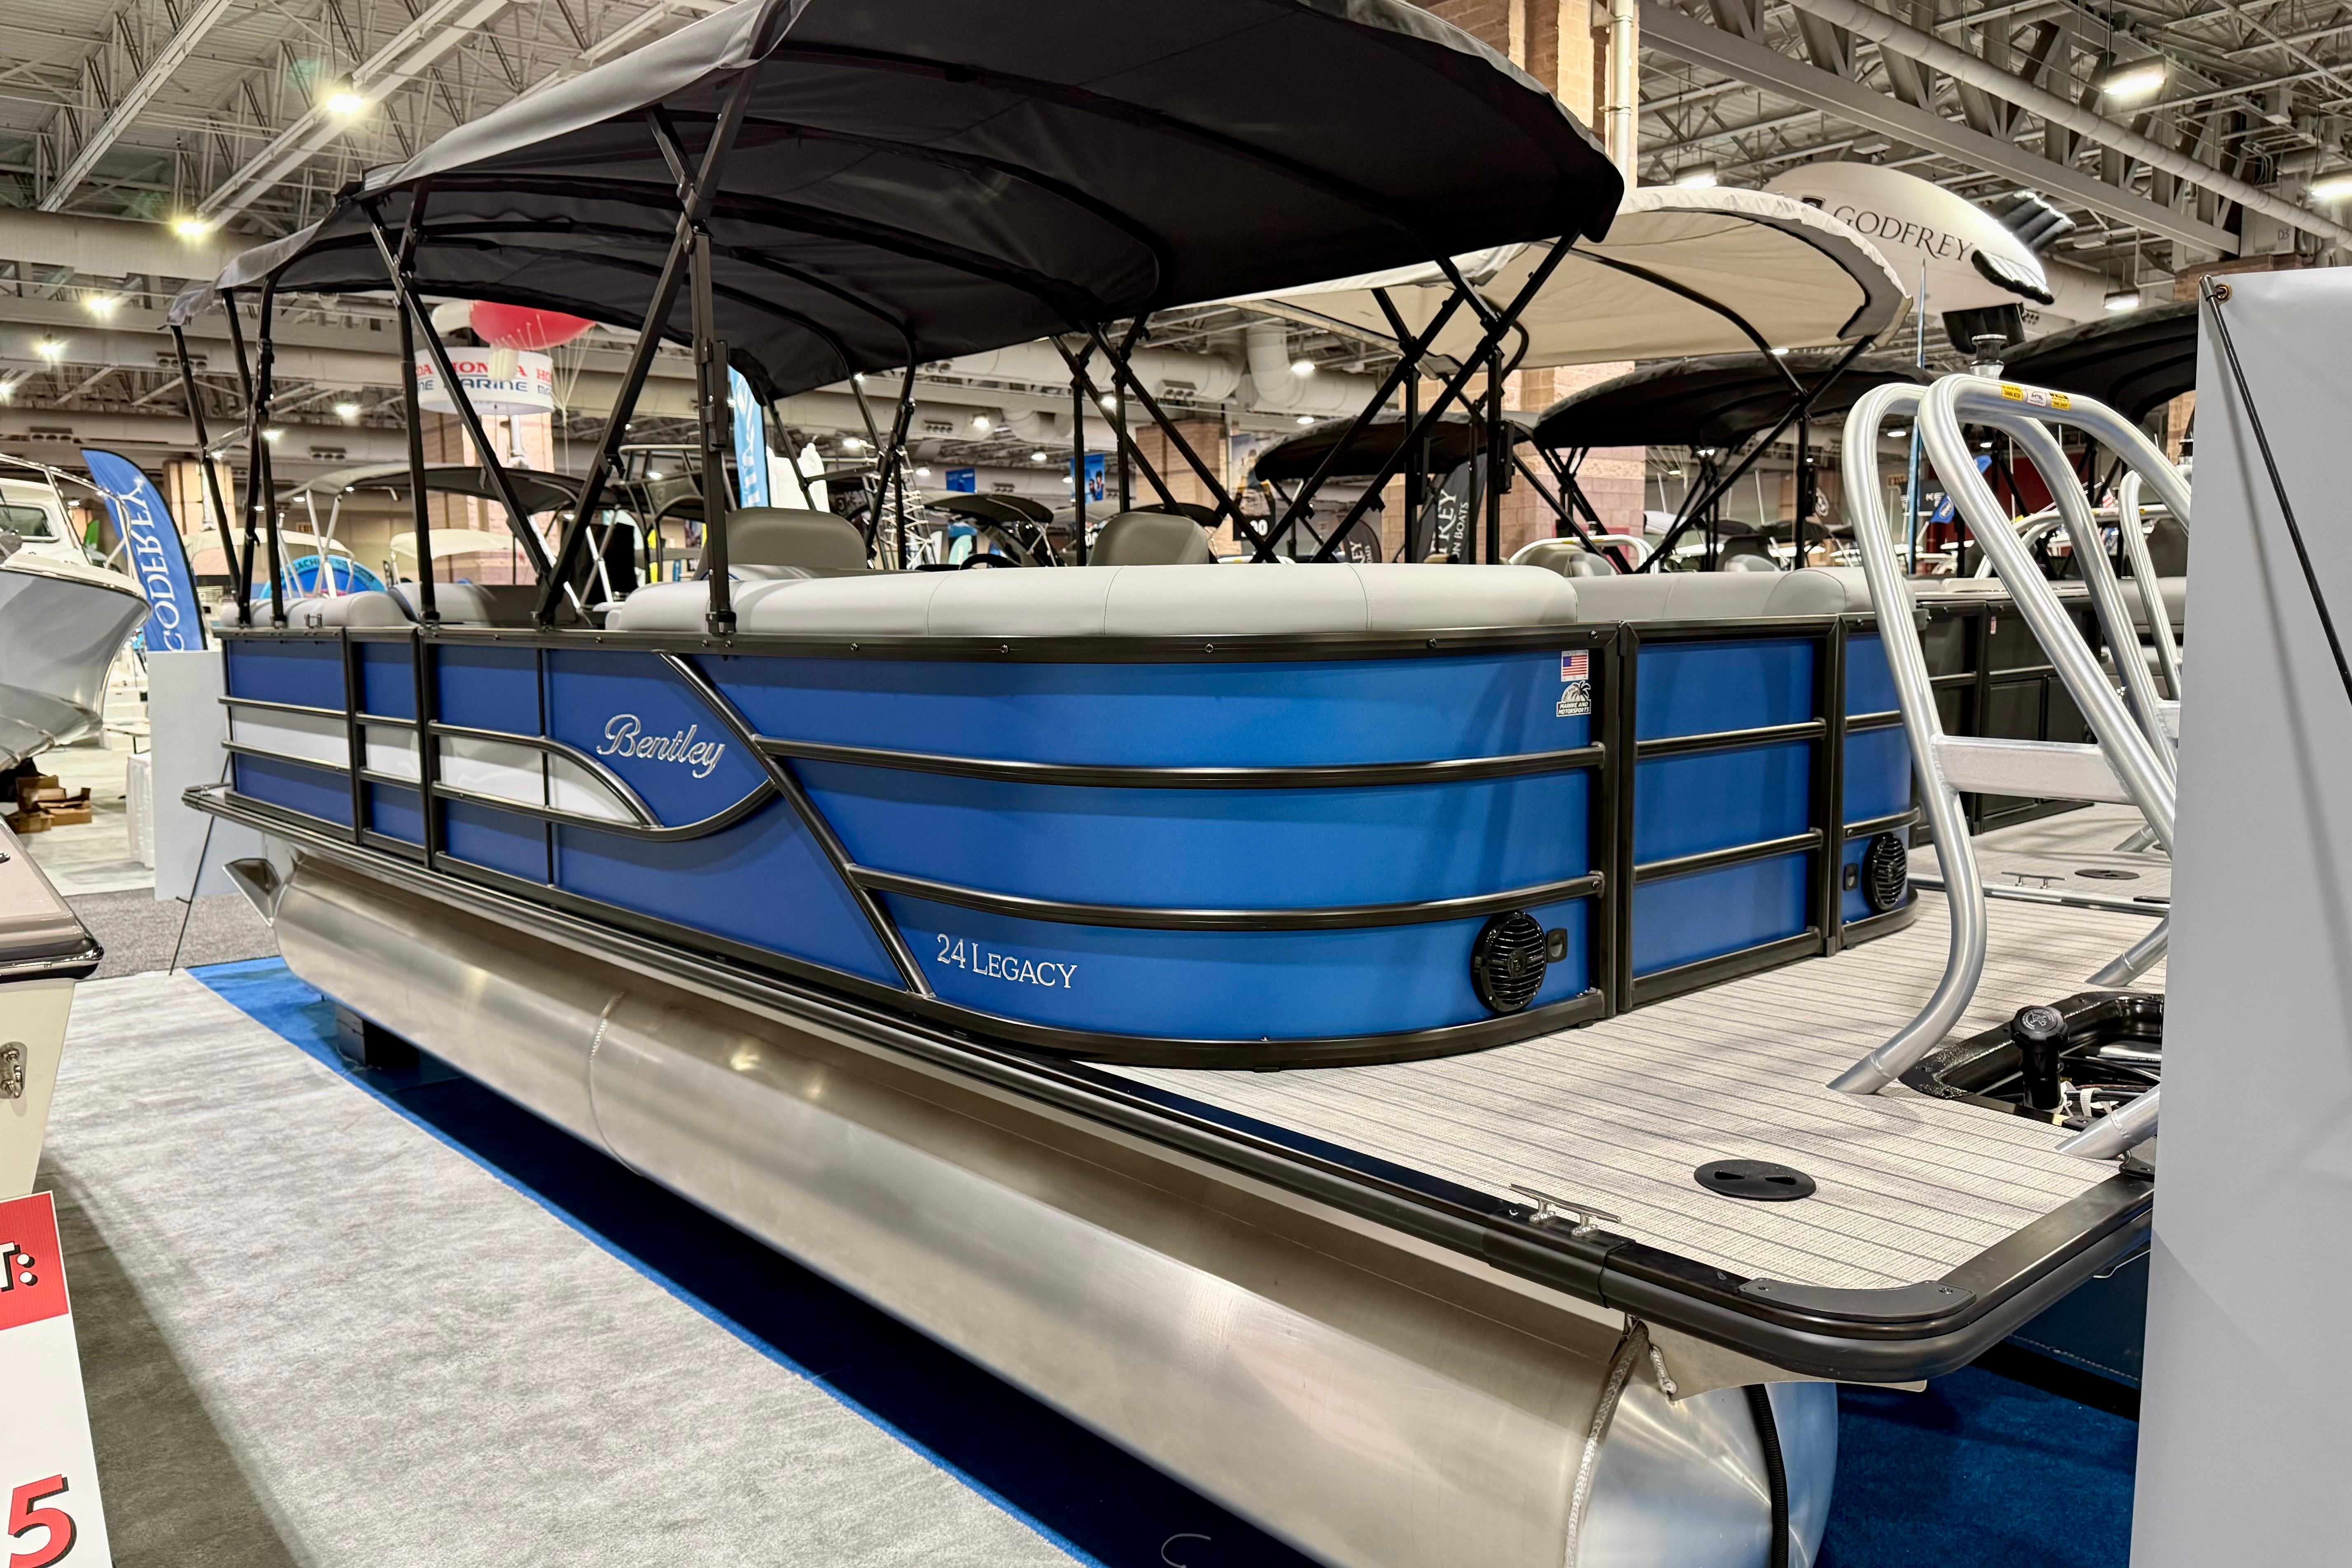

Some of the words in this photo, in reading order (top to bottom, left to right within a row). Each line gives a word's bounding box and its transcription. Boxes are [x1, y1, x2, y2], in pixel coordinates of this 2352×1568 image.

[1833, 205, 1973, 262] GODFREY
[460, 378, 528, 392] ARINE
[1453, 502, 1470, 539] BOATS
[1558, 707, 1589, 715] MOTORSPORTS
[596, 714, 725, 779] Bentley
[937, 933, 966, 969] 24
[972, 943, 1078, 989] LEGACY
